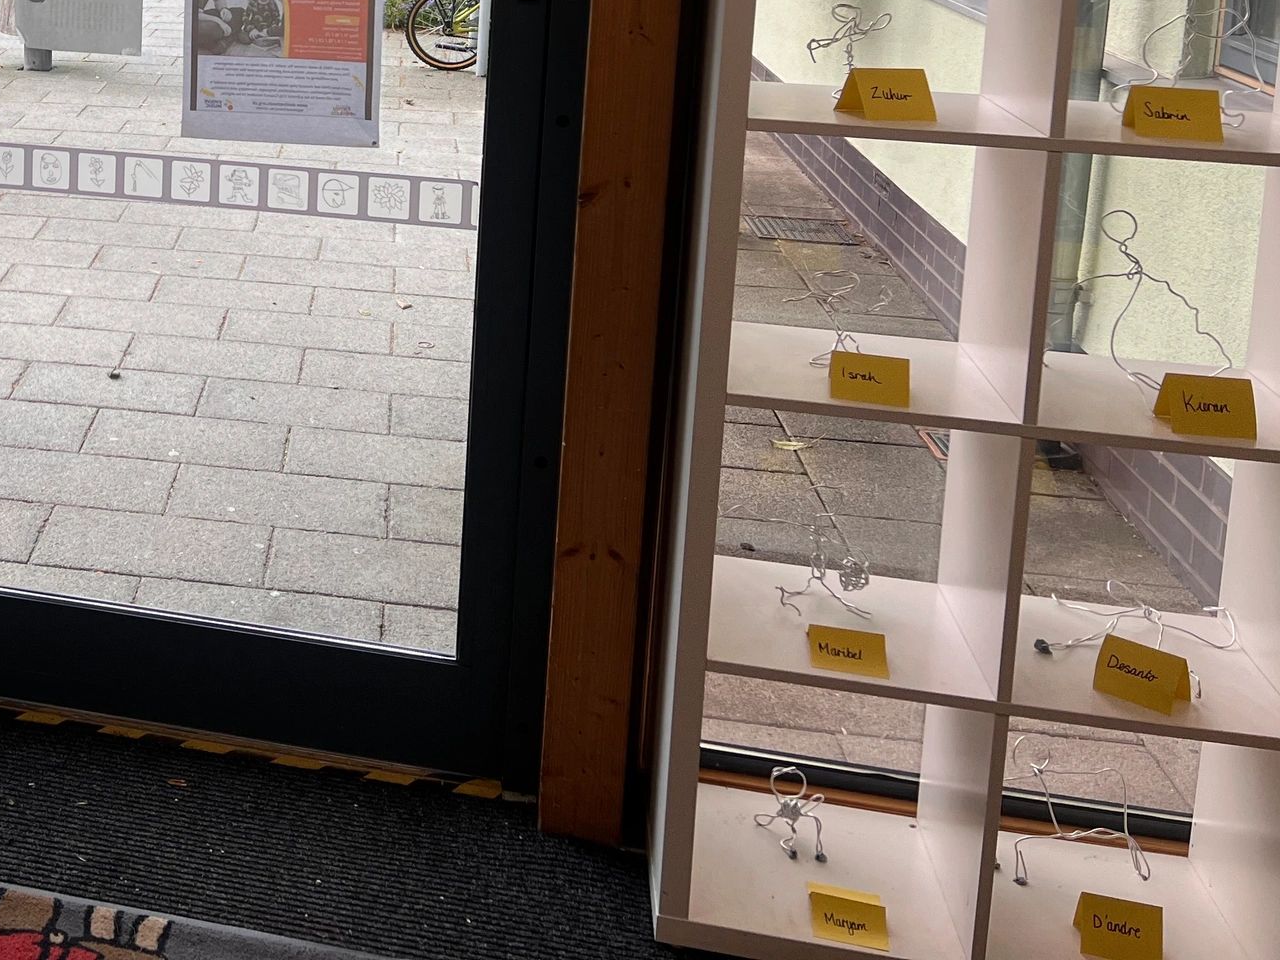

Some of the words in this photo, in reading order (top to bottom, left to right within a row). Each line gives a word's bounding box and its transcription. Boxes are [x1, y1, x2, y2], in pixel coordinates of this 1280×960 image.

[1144, 101, 1191, 121] Sabrin
[818, 642, 864, 661] Maribel
[824, 912, 868, 936] Maryam
[1093, 914, 1141, 939] D'andre
